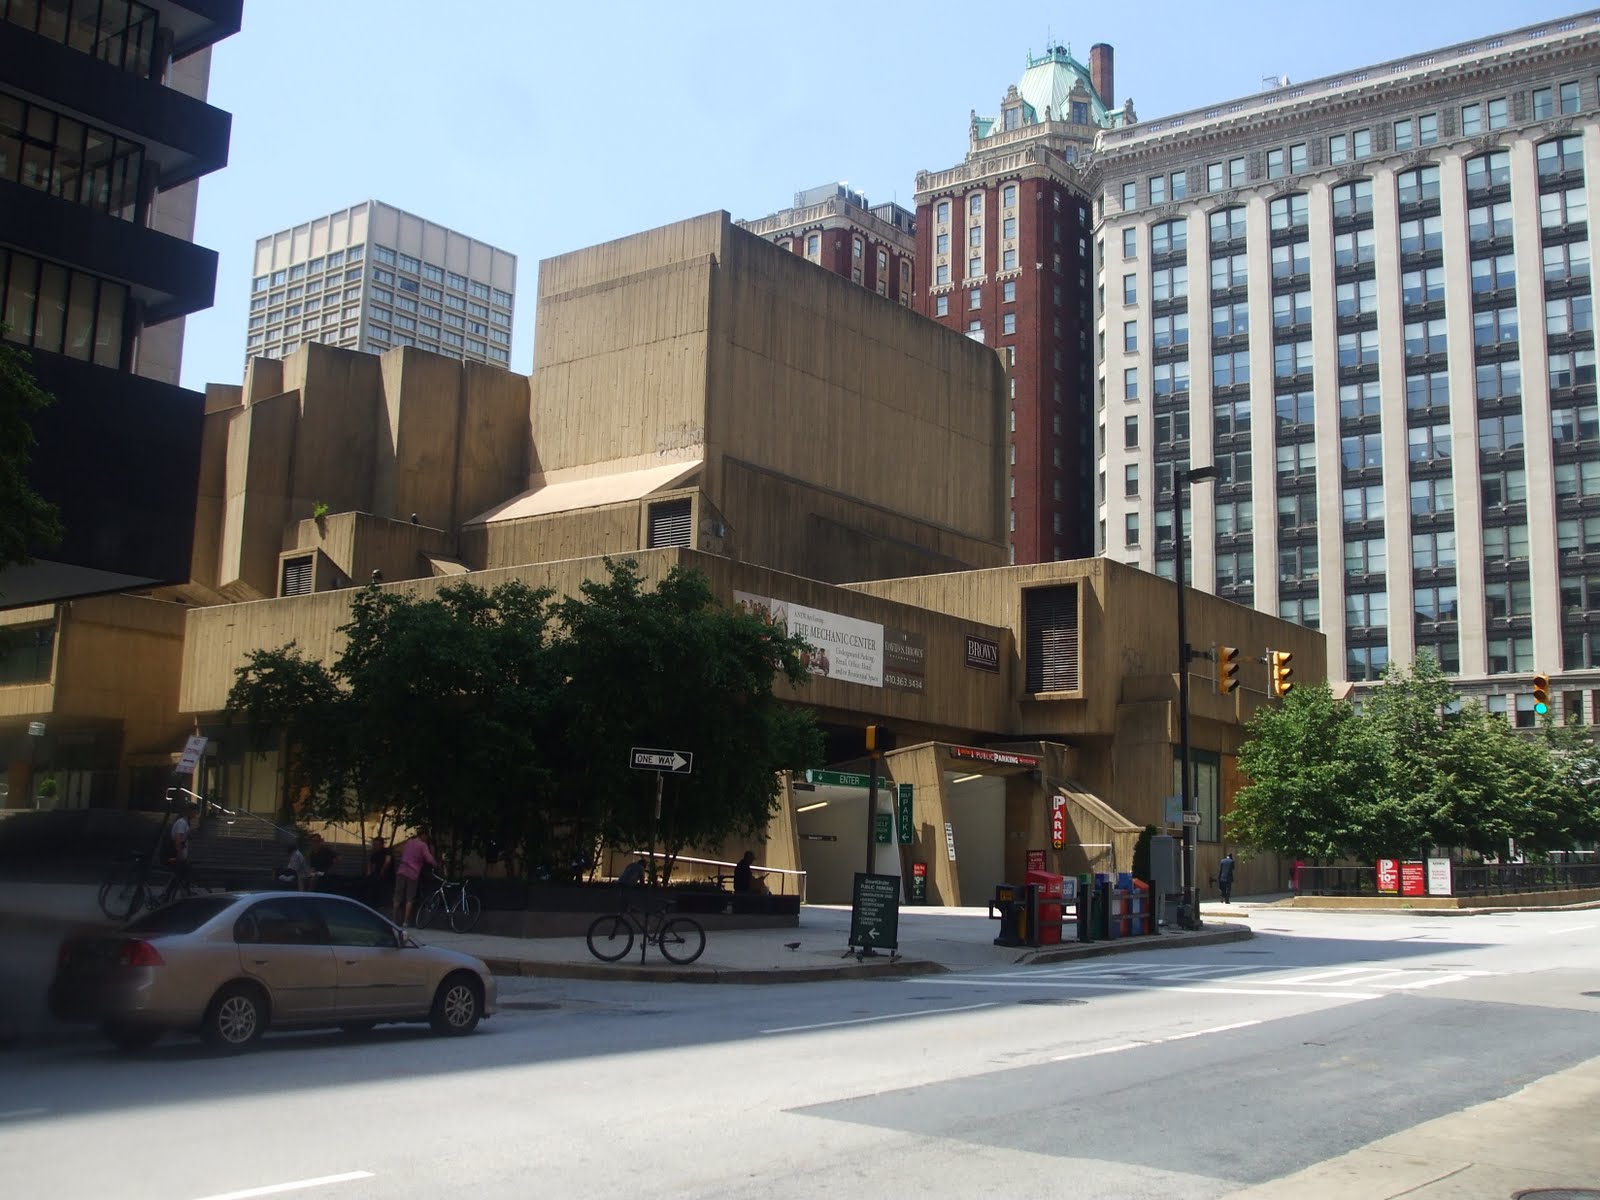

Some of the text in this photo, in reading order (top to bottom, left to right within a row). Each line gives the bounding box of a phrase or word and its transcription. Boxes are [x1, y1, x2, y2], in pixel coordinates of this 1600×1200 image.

[794, 622, 876, 651] THE MECHANIC CENTER
[968, 640, 997, 661] BROWN
[885, 674, 923, 689] 410.363.3434
[637, 754, 675, 765] ONE WAY
[975, 751, 994, 761] PUBLIC
[994, 752, 1018, 764] PARKING
[840, 775, 860, 784] ENTER
[1053, 795, 1066, 840] PARK
